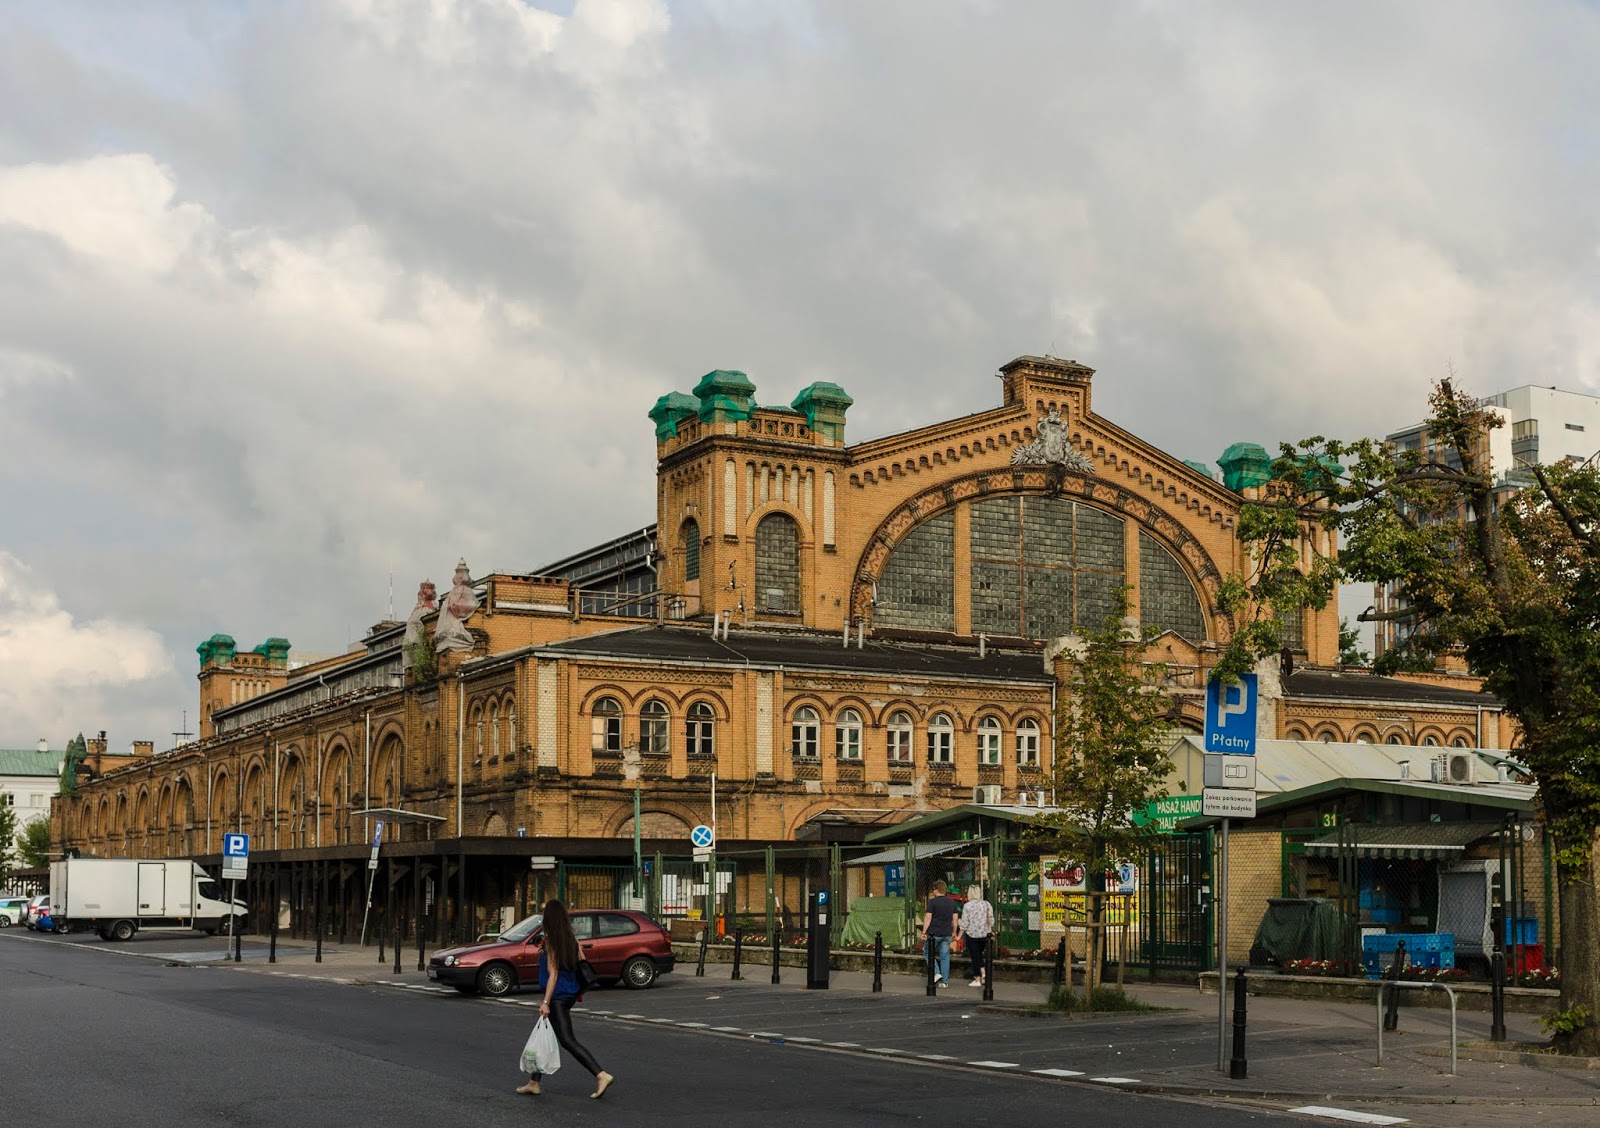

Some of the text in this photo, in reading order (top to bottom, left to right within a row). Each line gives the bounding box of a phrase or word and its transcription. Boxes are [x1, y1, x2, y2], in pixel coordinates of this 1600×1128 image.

[1217, 679, 1248, 728] P
[1212, 733, 1250, 751] Płatny
[1157, 798, 1179, 814] PASAŻ
[1323, 813, 1337, 827] 31
[229, 836, 245, 855] P
[819, 892, 826, 903] P
